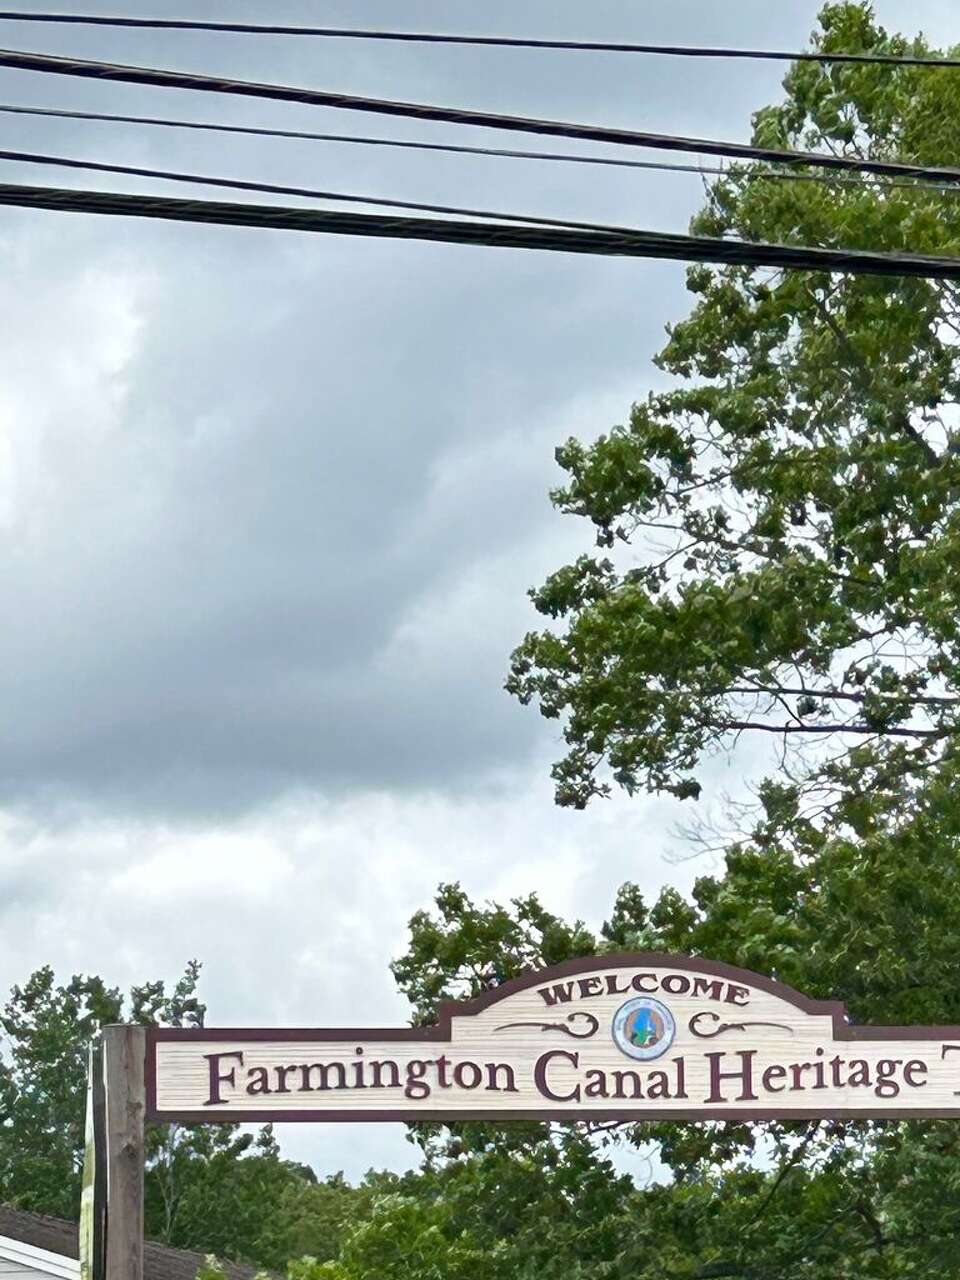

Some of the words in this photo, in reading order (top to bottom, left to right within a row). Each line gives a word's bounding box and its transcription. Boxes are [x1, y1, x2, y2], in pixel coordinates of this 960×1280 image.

[537, 973, 750, 1006] WELCOME
[203, 1047, 518, 1105] Farmington
[533, 1049, 689, 1103] Canal
[703, 1047, 928, 1104] Heritage
